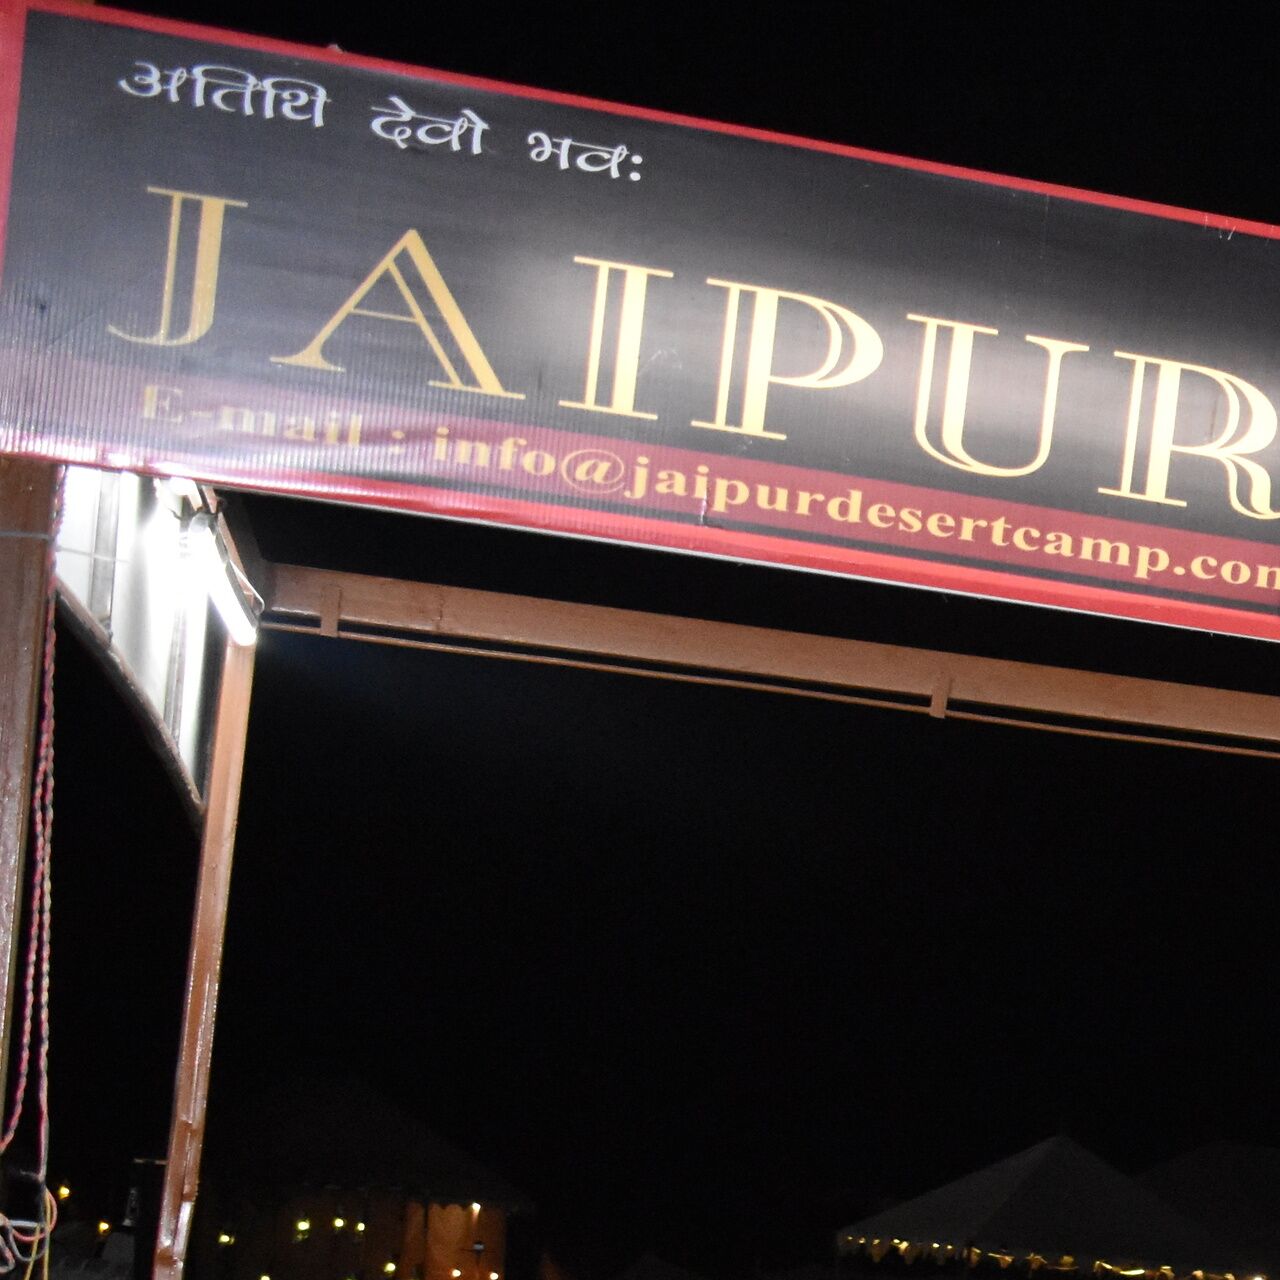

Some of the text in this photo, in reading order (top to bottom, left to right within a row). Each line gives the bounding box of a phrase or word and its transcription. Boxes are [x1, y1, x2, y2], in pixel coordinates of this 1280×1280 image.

[119, 61, 333, 127] अतिथि
[371, 95, 490, 155] देवो
[143, 384, 362, 447] E-mail
